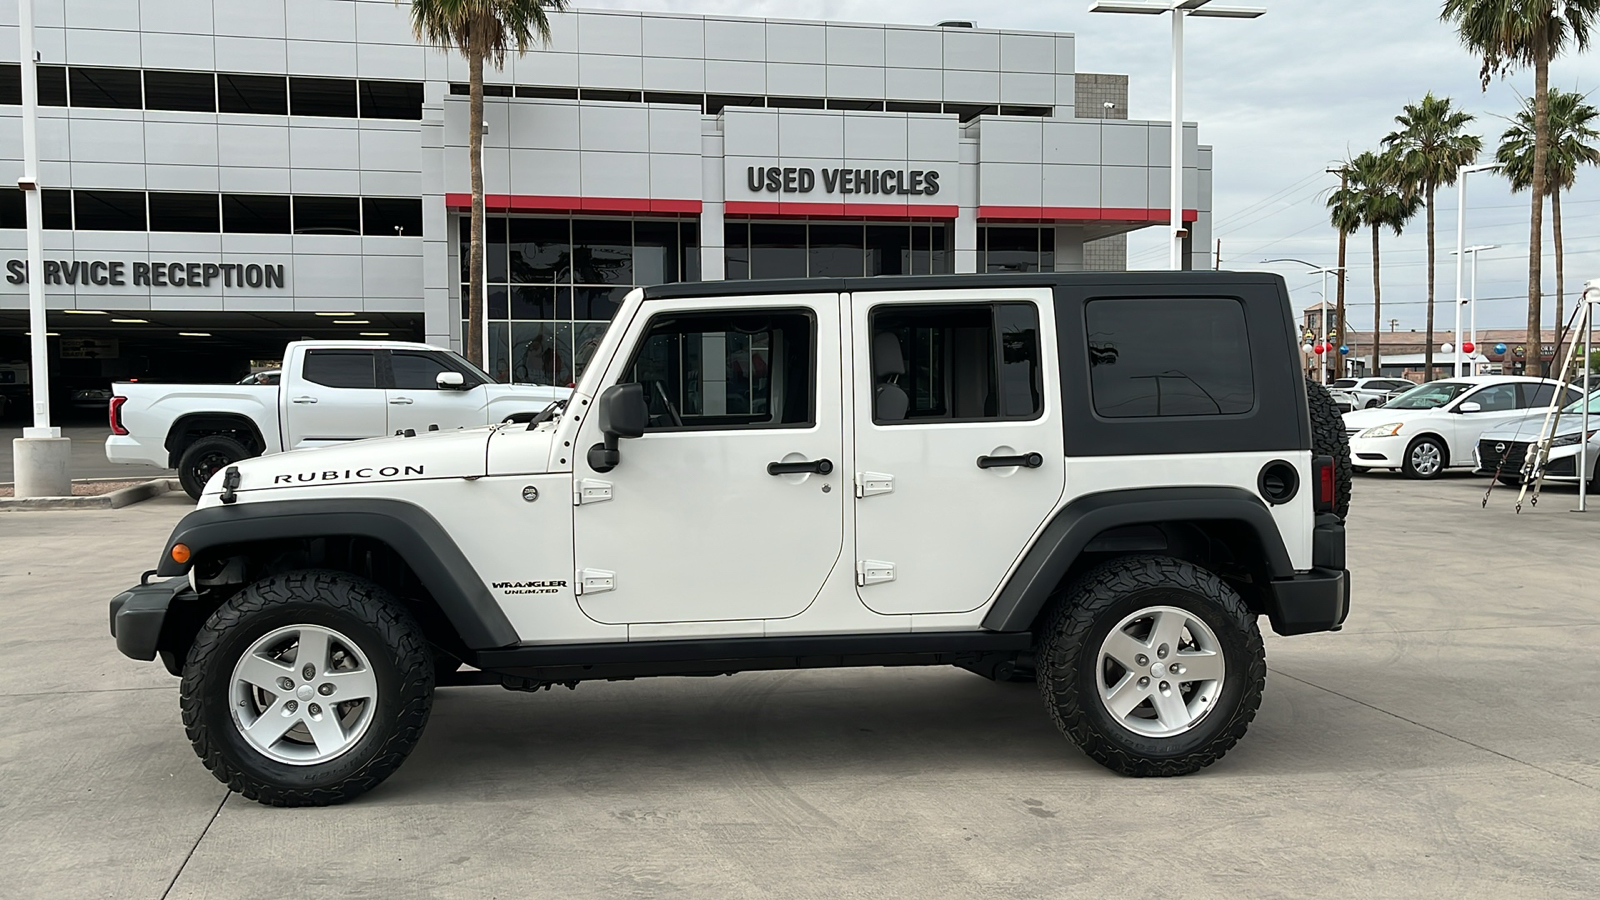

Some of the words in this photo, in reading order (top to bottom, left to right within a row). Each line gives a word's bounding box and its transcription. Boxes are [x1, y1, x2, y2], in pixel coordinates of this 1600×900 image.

[747, 166, 815, 193] USED
[822, 168, 940, 195] VEHICLES
[133, 262, 285, 288] RECEPTION
[274, 465, 424, 484] RUBICON
[492, 580, 567, 588] WRANGLER
